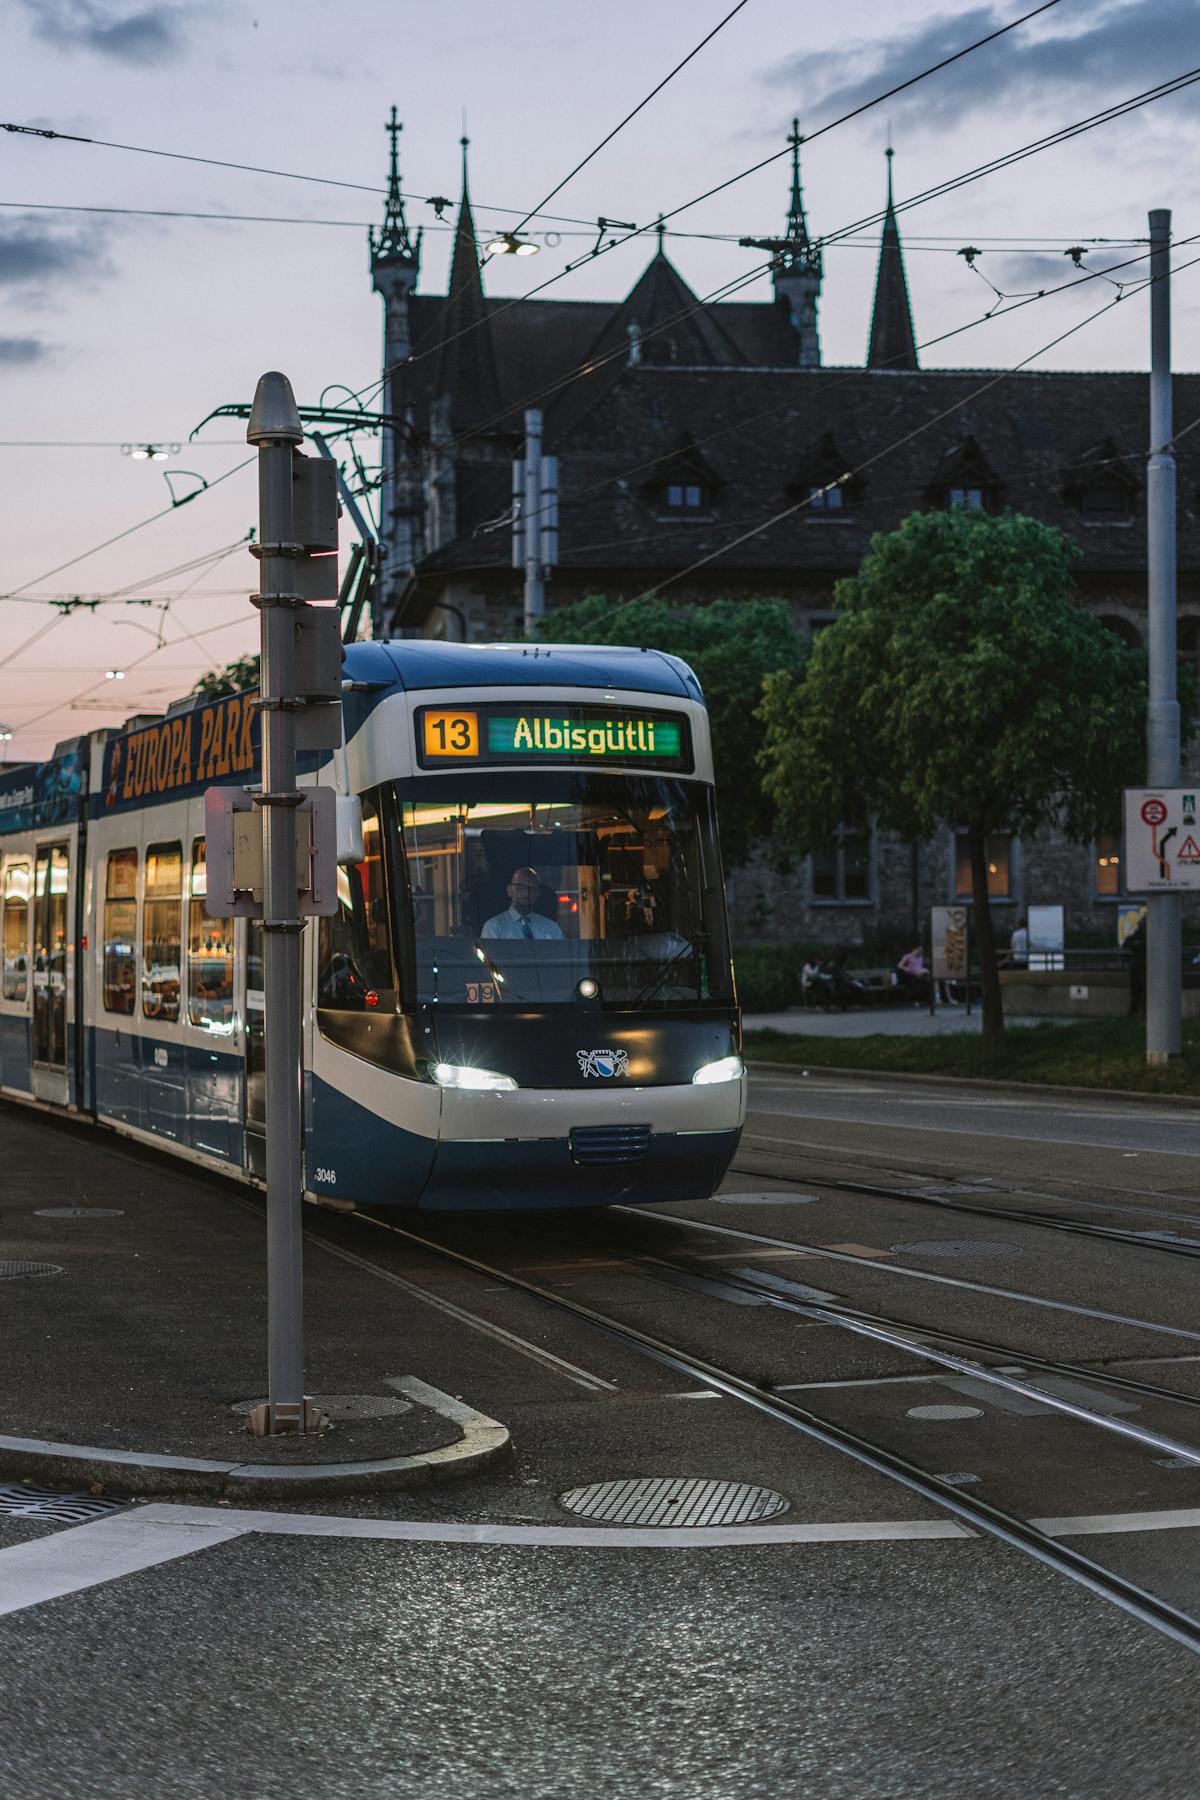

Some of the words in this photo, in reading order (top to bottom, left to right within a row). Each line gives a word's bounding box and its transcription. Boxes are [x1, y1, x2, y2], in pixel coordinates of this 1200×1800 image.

[123, 715, 192, 799] EUROPA
[197, 691, 259, 781] PARK
[432, 719, 471, 750] 13
[513, 717, 655, 754] Albisgütli
[316, 1167, 337, 1184] 3046
